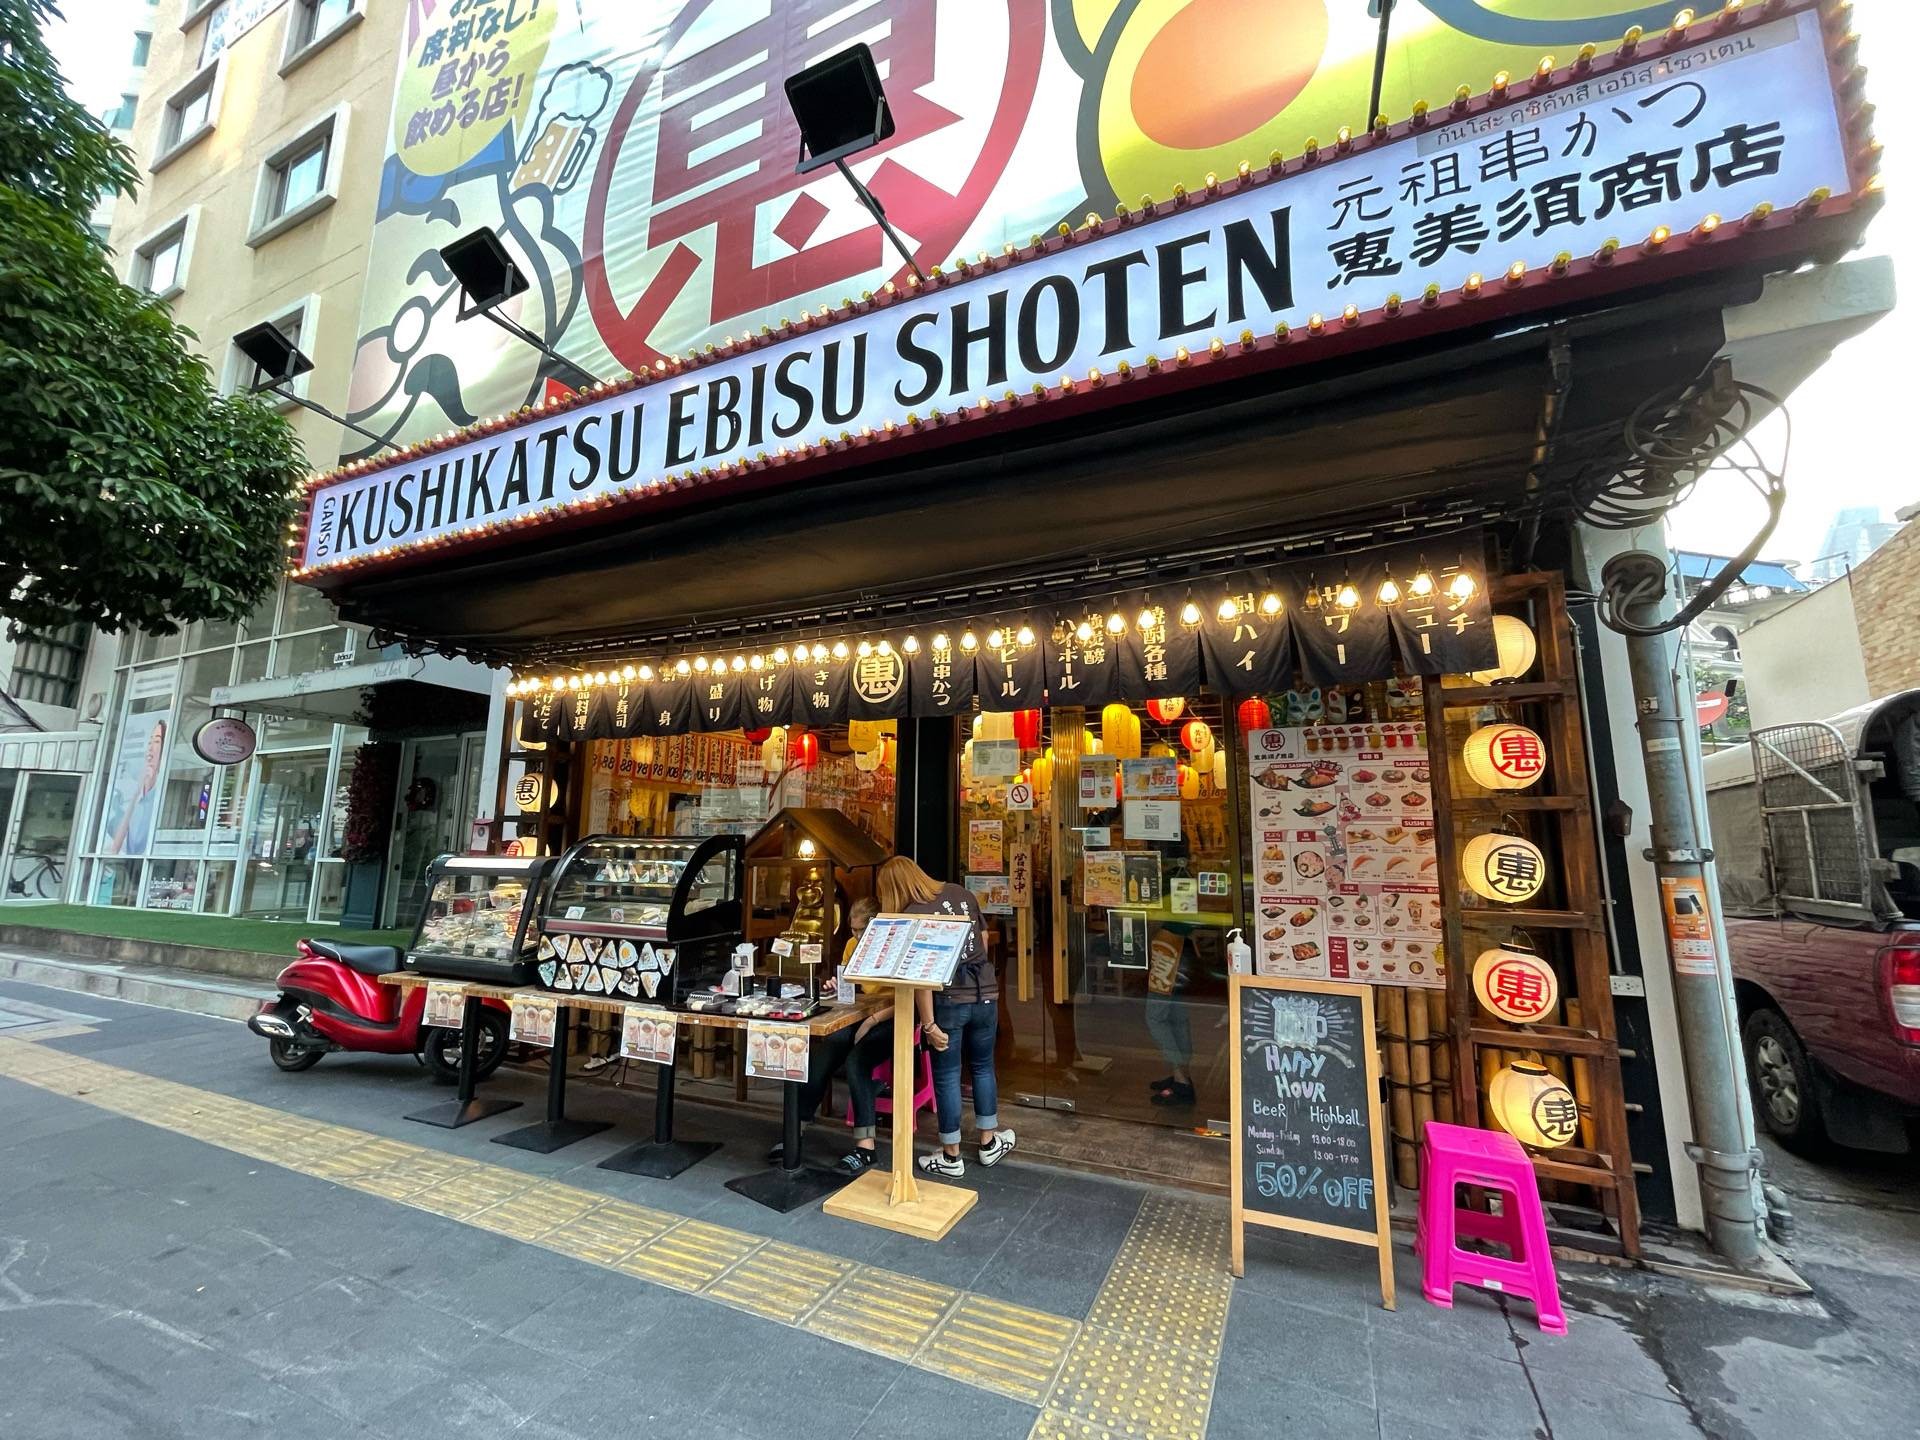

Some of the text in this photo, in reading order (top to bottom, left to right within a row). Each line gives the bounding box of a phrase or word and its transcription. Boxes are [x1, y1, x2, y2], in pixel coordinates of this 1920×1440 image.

[430, 39, 510, 101] 昼から
[1332, 81, 1707, 231] 元祖串かつ
[335, 205, 1295, 554] KUSHIKATSU EBISU SHOTEN
[315, 496, 337, 558] GANSO
[1274, 1072, 1327, 1103] HOUR
[1255, 1161, 1373, 1210] 50% OFF
